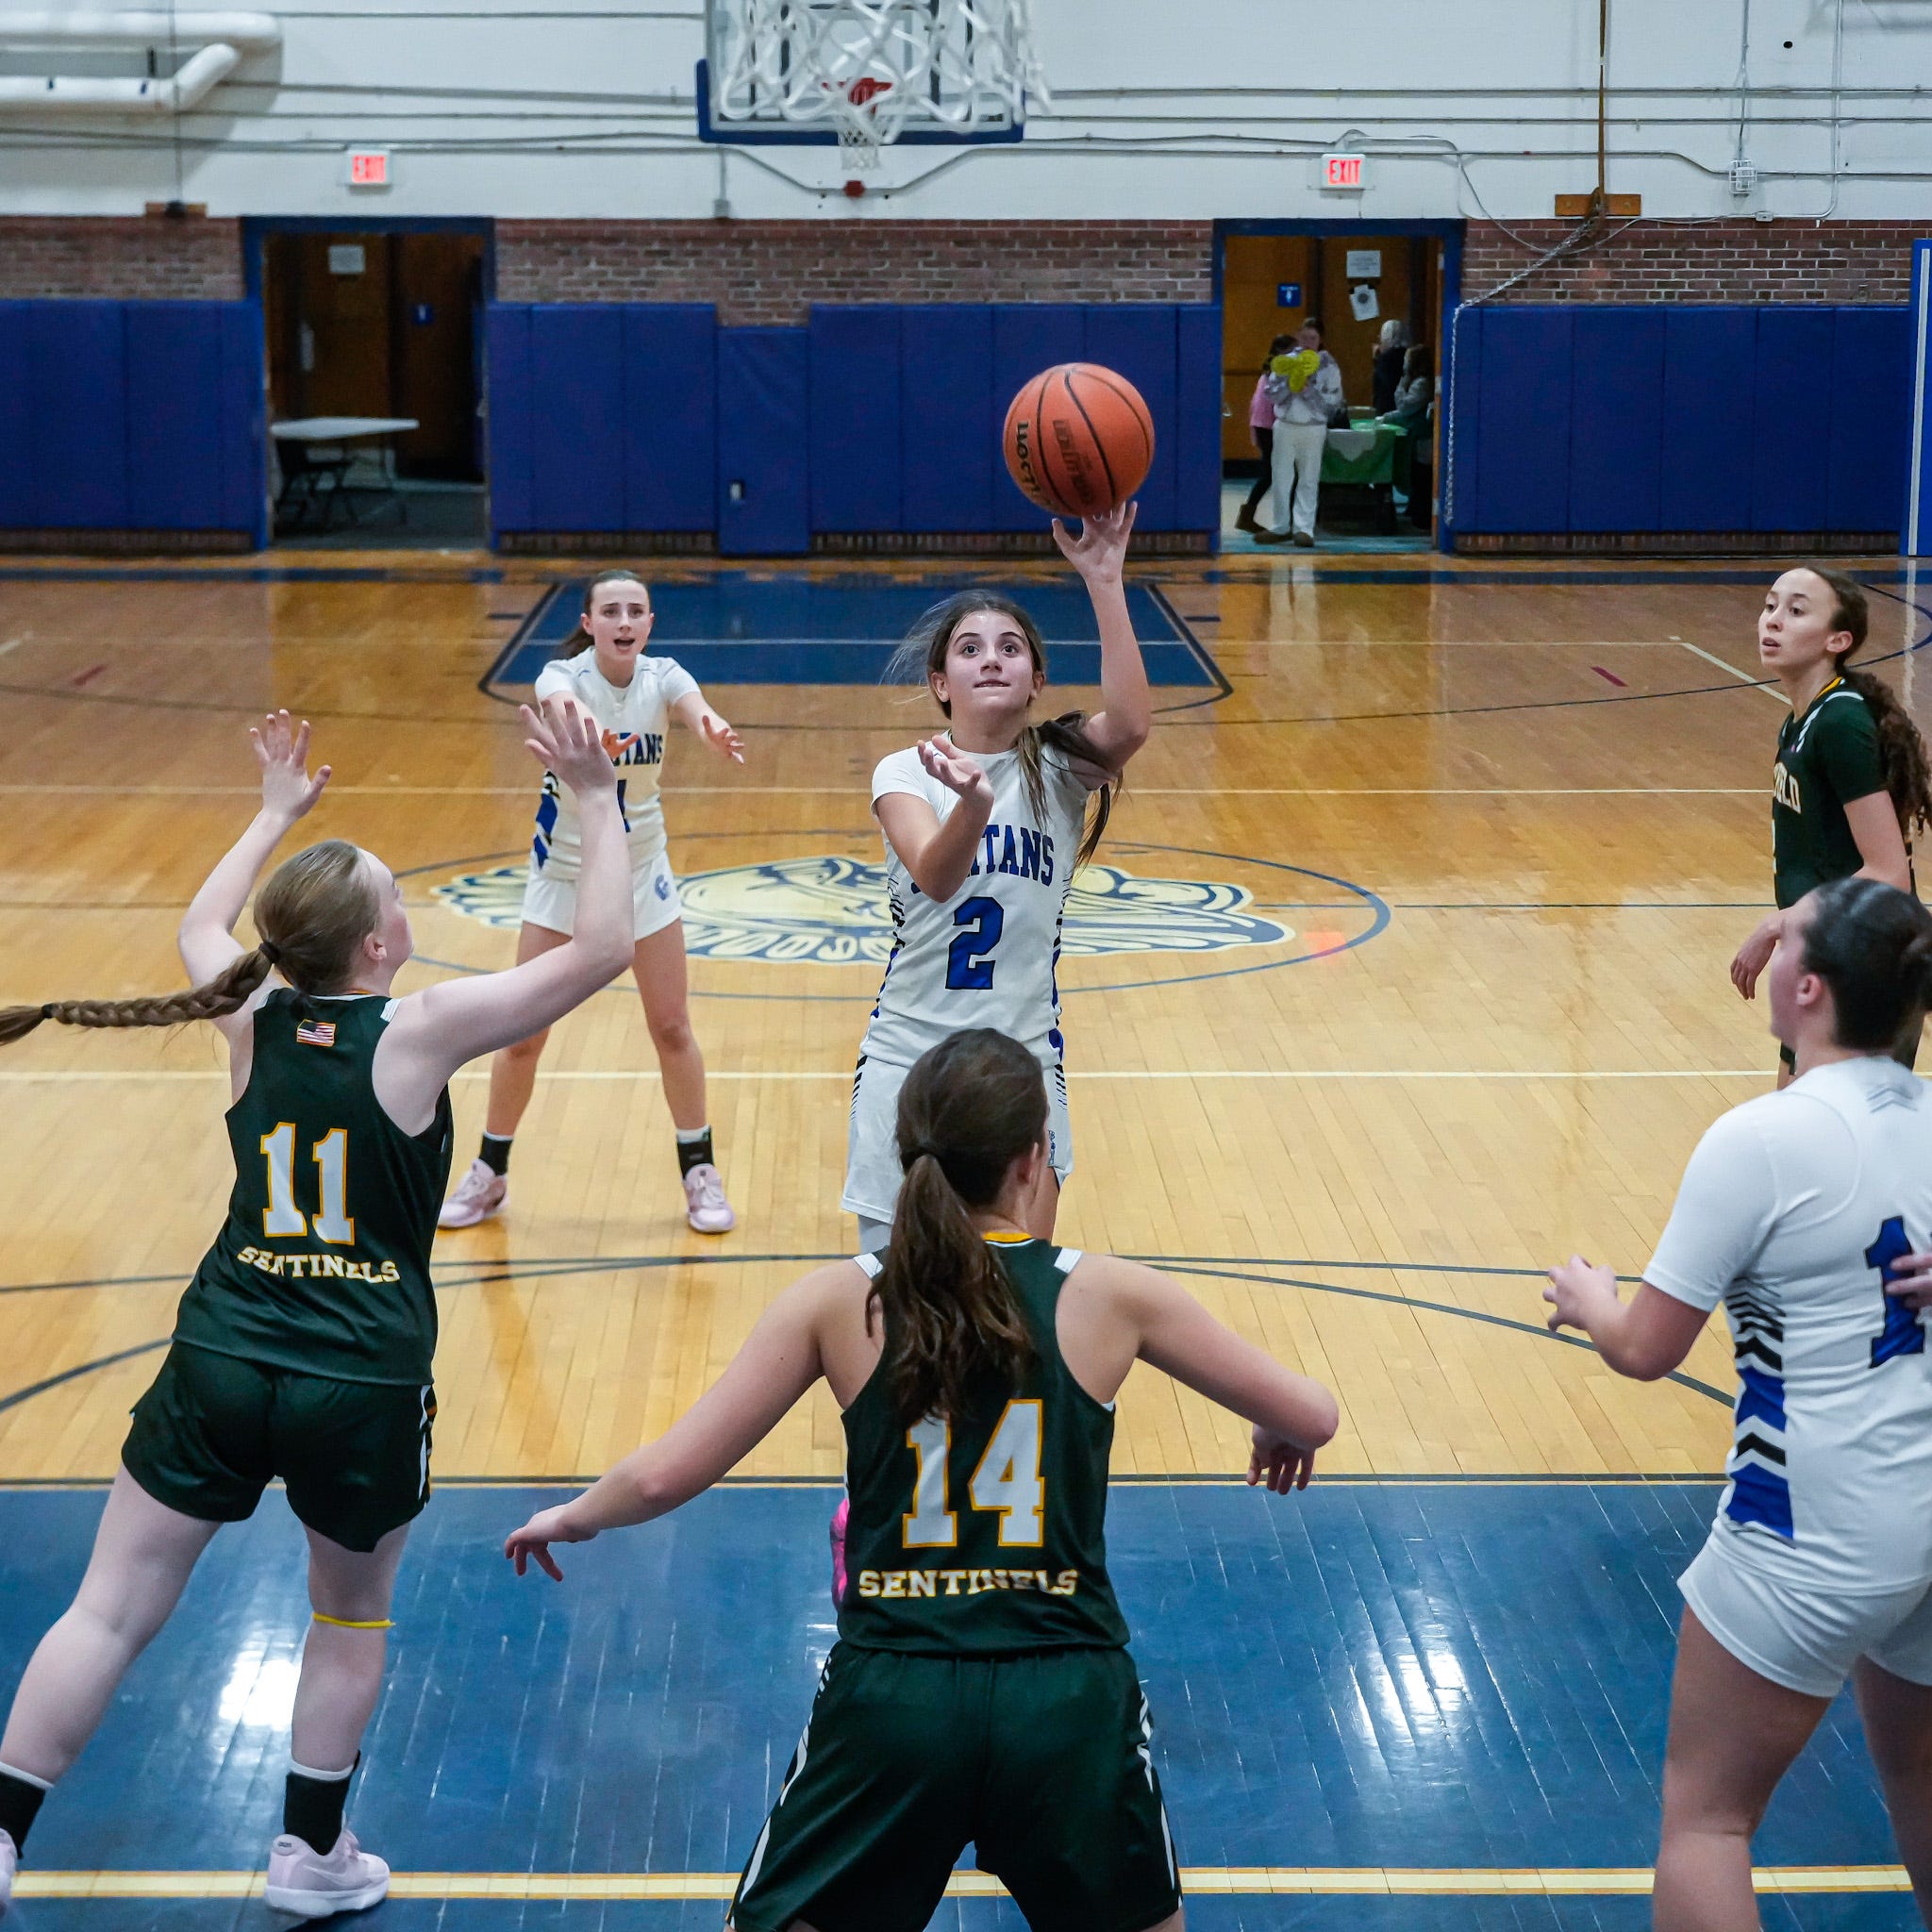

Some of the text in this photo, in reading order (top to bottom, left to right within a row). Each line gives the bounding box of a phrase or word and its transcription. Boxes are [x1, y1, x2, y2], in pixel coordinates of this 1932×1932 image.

[1328, 159, 1360, 185] EXIT
[945, 896, 1004, 990] 2
[260, 1121, 355, 1246] 11
[902, 1398, 1045, 1549] 14
[858, 1568, 1079, 1598] SENTINELS
